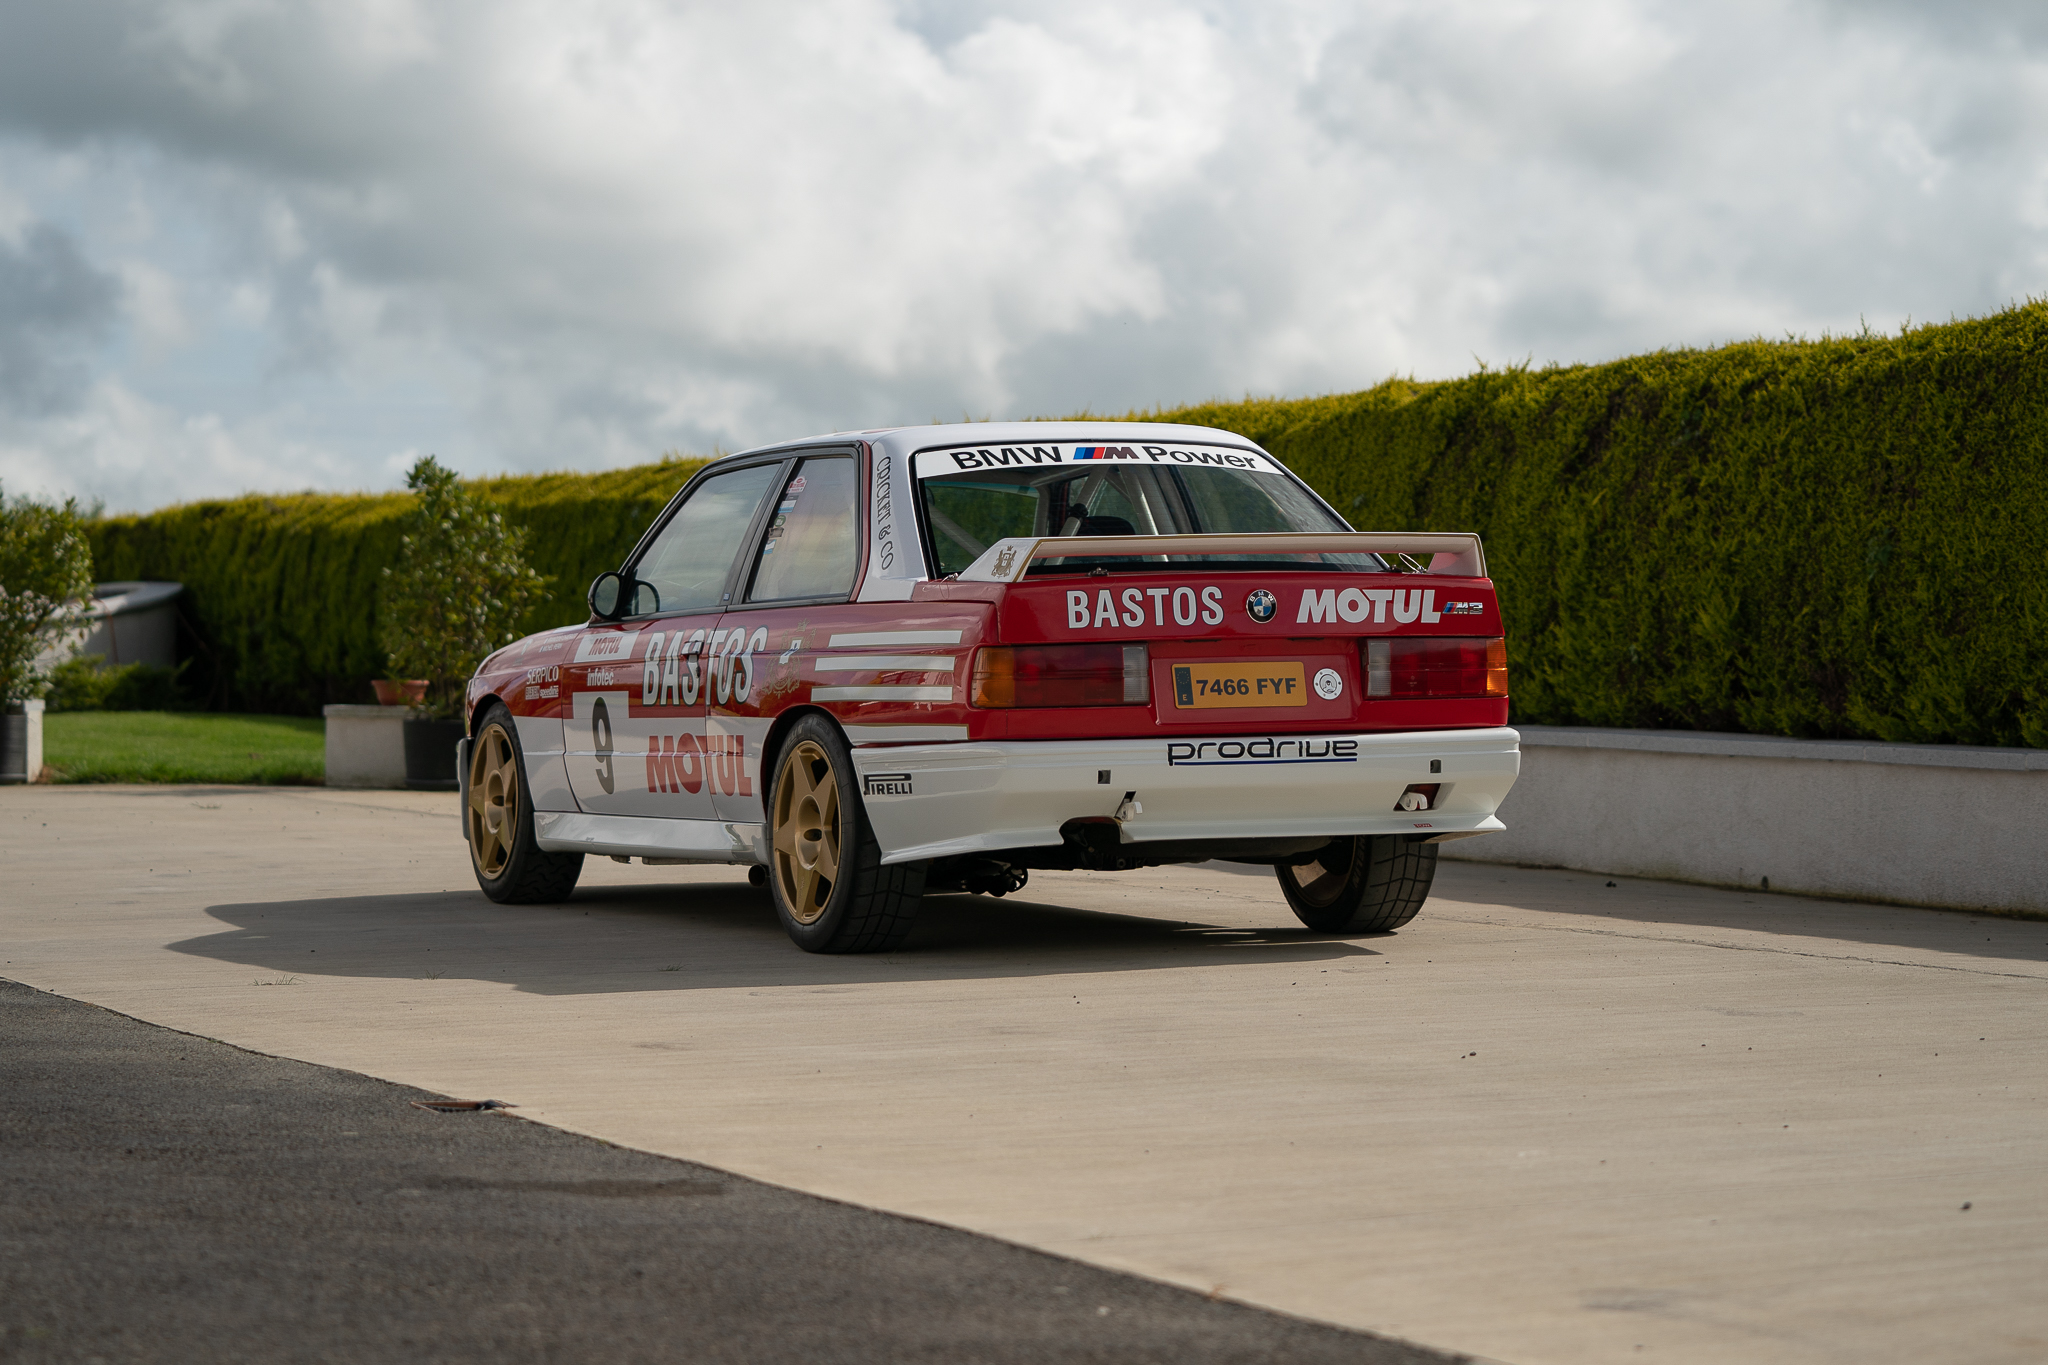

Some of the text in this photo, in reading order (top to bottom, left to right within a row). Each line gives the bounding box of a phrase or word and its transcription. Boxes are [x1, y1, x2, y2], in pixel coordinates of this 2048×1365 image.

[949, 447, 1063, 469] BMW
[1141, 446, 1257, 469] Power
[877, 456, 894, 570] CRICKET & CO
[1066, 586, 1225, 629] BASTOS
[1296, 588, 1441, 624] MOTUL
[588, 636, 623, 656] MOTUL
[526, 666, 560, 685] SERPICO
[587, 667, 614, 687] infotec
[642, 625, 769, 707] BASTOS
[1196, 677, 1297, 696] 7466 FYF
[592, 696, 615, 795] 9
[1167, 738, 1359, 766] prodrive
[645, 732, 753, 797] MOTUL
[863, 773, 913, 796] PIRELLI
